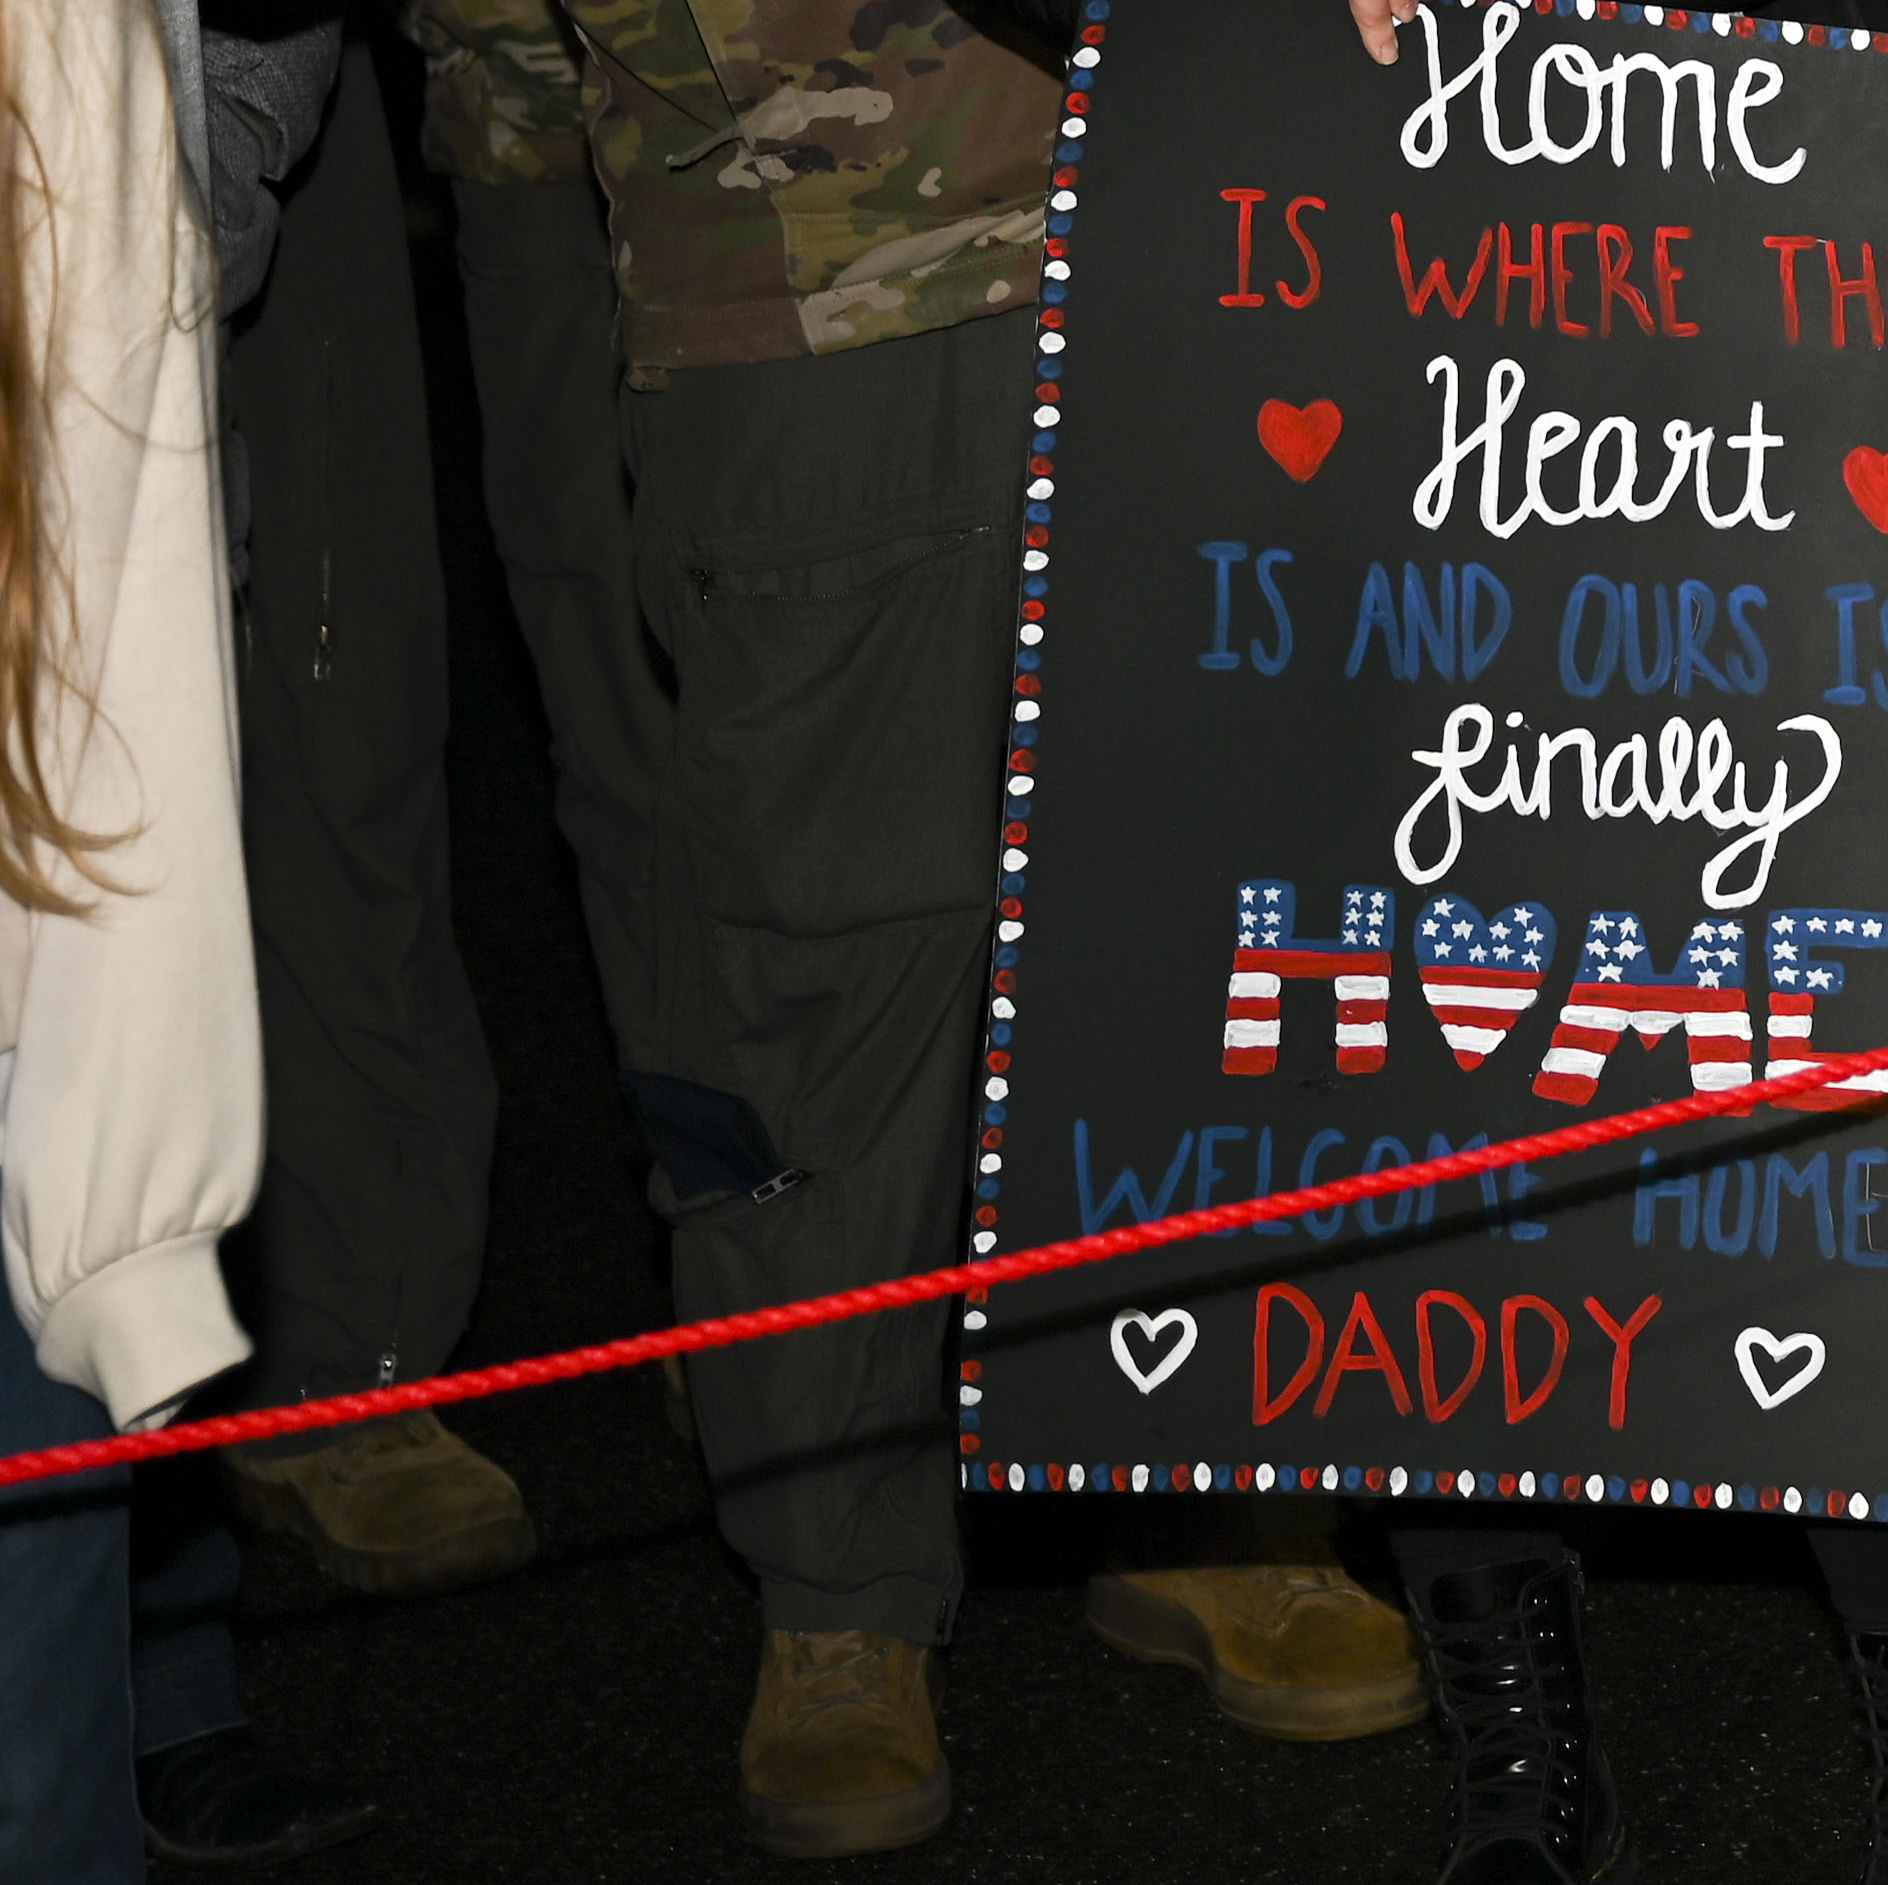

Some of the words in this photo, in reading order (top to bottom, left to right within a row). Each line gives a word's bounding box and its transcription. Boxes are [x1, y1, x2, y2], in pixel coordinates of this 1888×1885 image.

[1400, 2, 1808, 186] Home
[1219, 188, 1327, 309] IS
[1391, 212, 1700, 339] WHERE
[1412, 355, 1796, 539] Heart
[1196, 541, 1296, 676] IS
[1344, 559, 1515, 682] AND
[1559, 574, 1770, 700] OURS
[1250, 1283, 1664, 1430] DADDY
